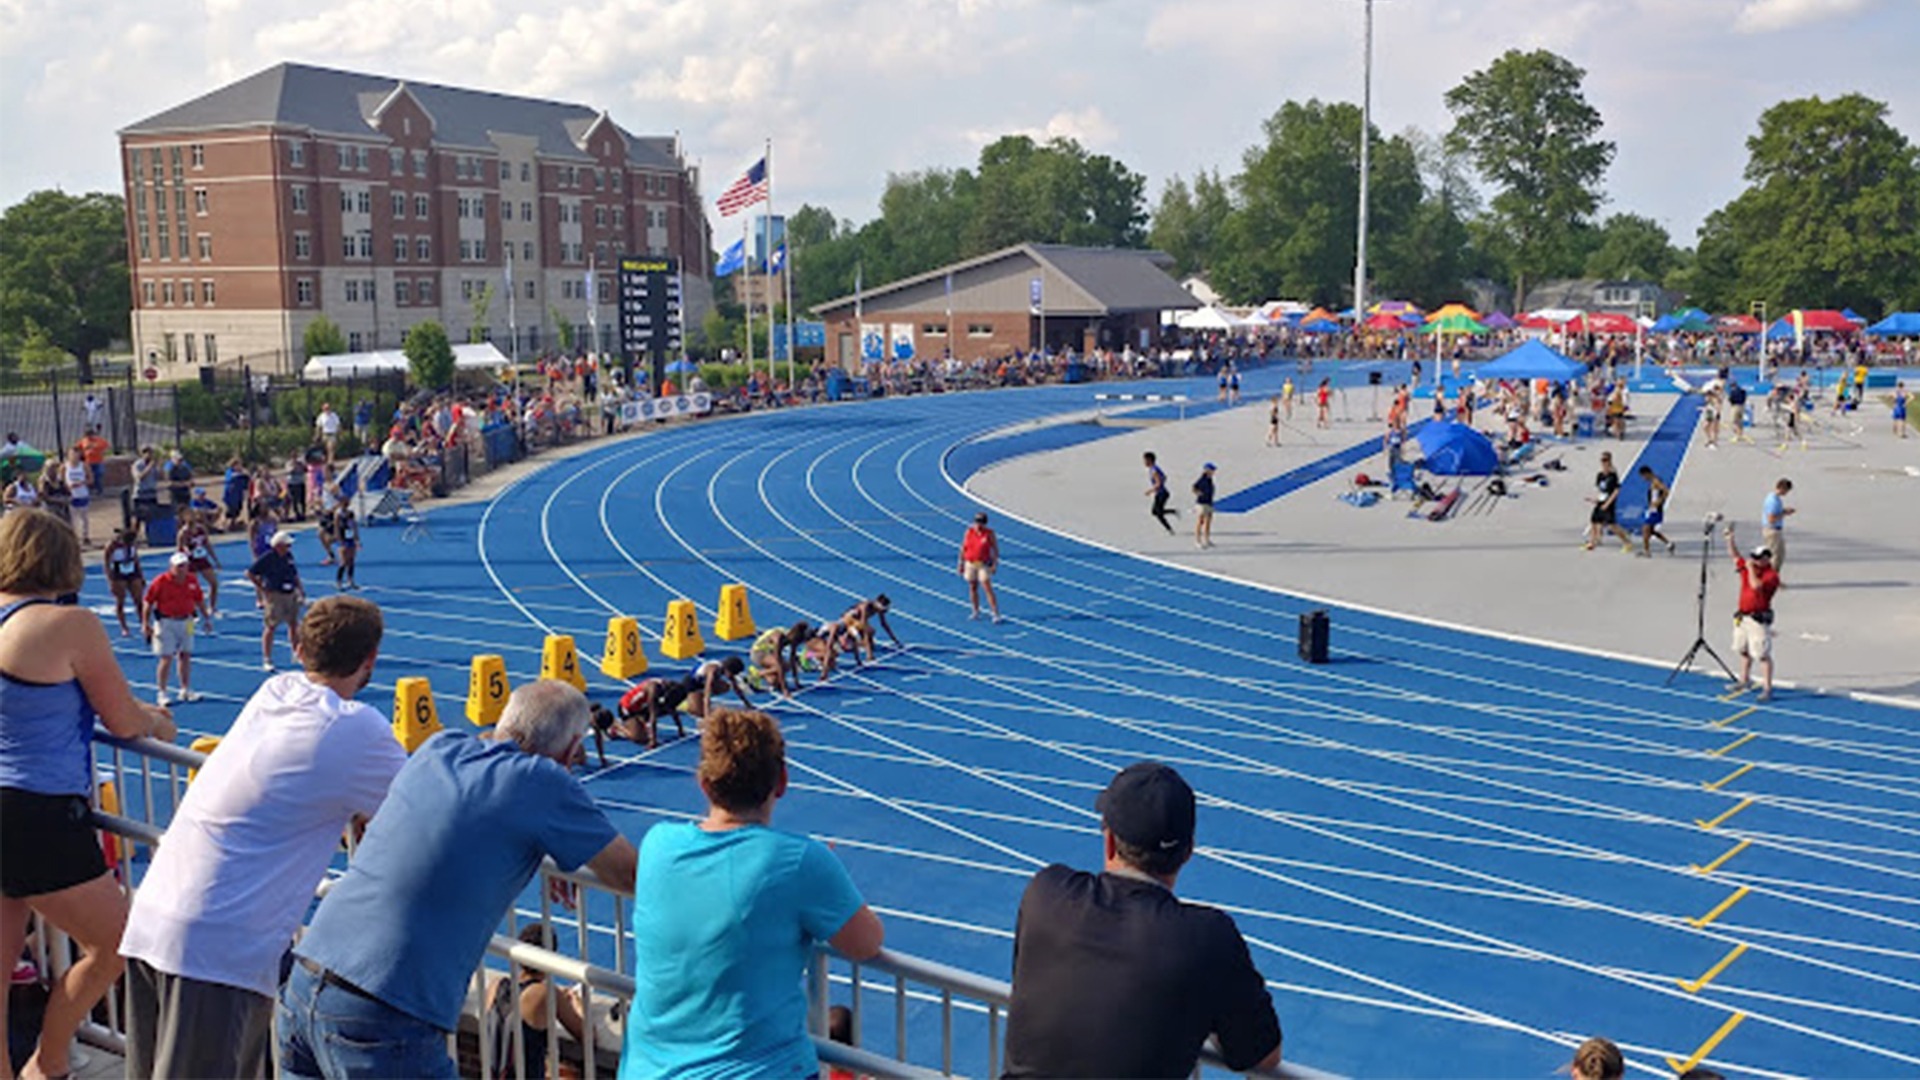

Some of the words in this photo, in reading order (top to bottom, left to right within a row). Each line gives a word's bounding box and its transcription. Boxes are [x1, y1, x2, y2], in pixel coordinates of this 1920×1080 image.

[735, 599, 743, 623] 1
[686, 614, 695, 637] 2
[627, 631, 637, 656] 3
[563, 651, 574, 677] 4
[489, 671, 503, 699] 5
[416, 695, 431, 724] 6
